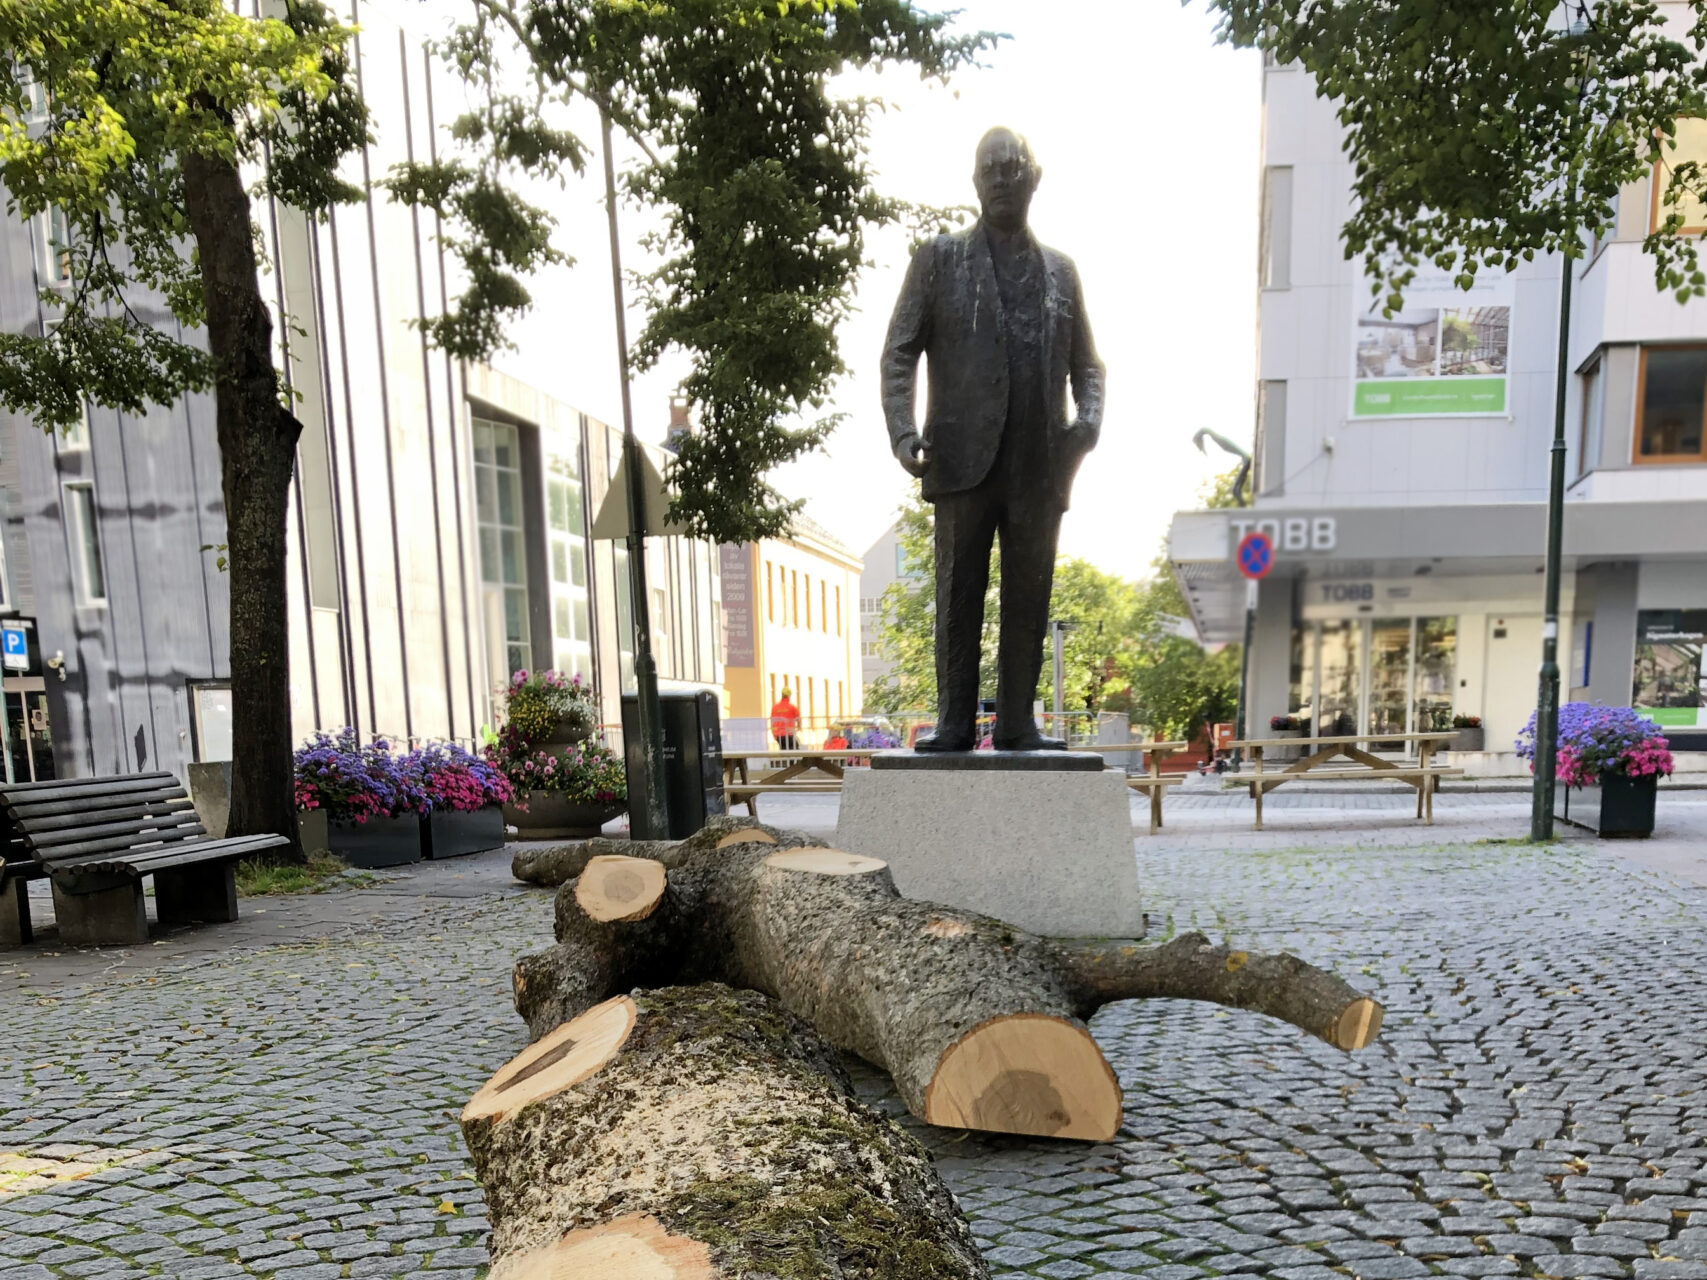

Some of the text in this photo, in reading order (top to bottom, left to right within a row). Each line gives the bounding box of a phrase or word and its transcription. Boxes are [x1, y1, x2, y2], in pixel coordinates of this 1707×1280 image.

[1231, 517, 1337, 551] TOBB
[1321, 583, 1374, 601] TOBB
[7, 633, 20, 652] P
